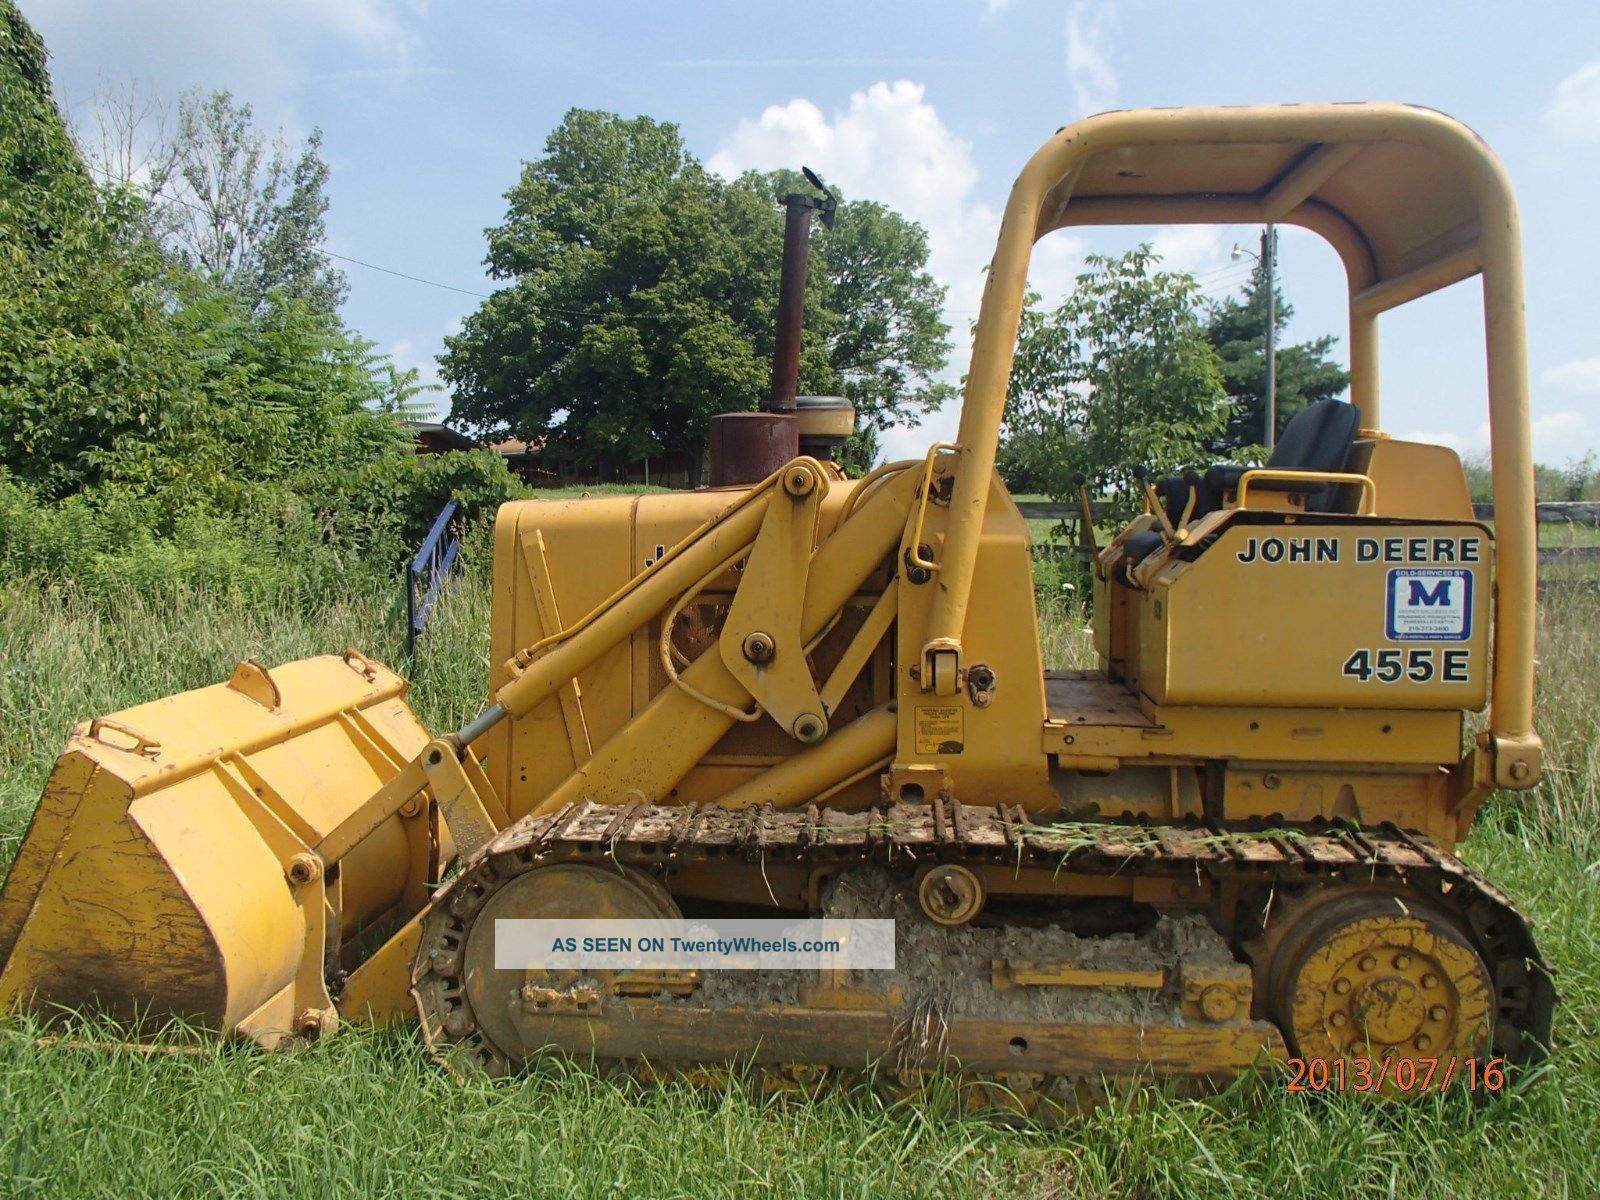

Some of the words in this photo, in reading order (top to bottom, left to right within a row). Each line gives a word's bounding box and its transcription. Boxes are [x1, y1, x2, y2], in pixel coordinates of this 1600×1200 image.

[1237, 537, 1339, 563] JOHN
[1356, 537, 1480, 563] DEERE
[1408, 580, 1451, 605] M
[1342, 648, 1470, 682] 455E
